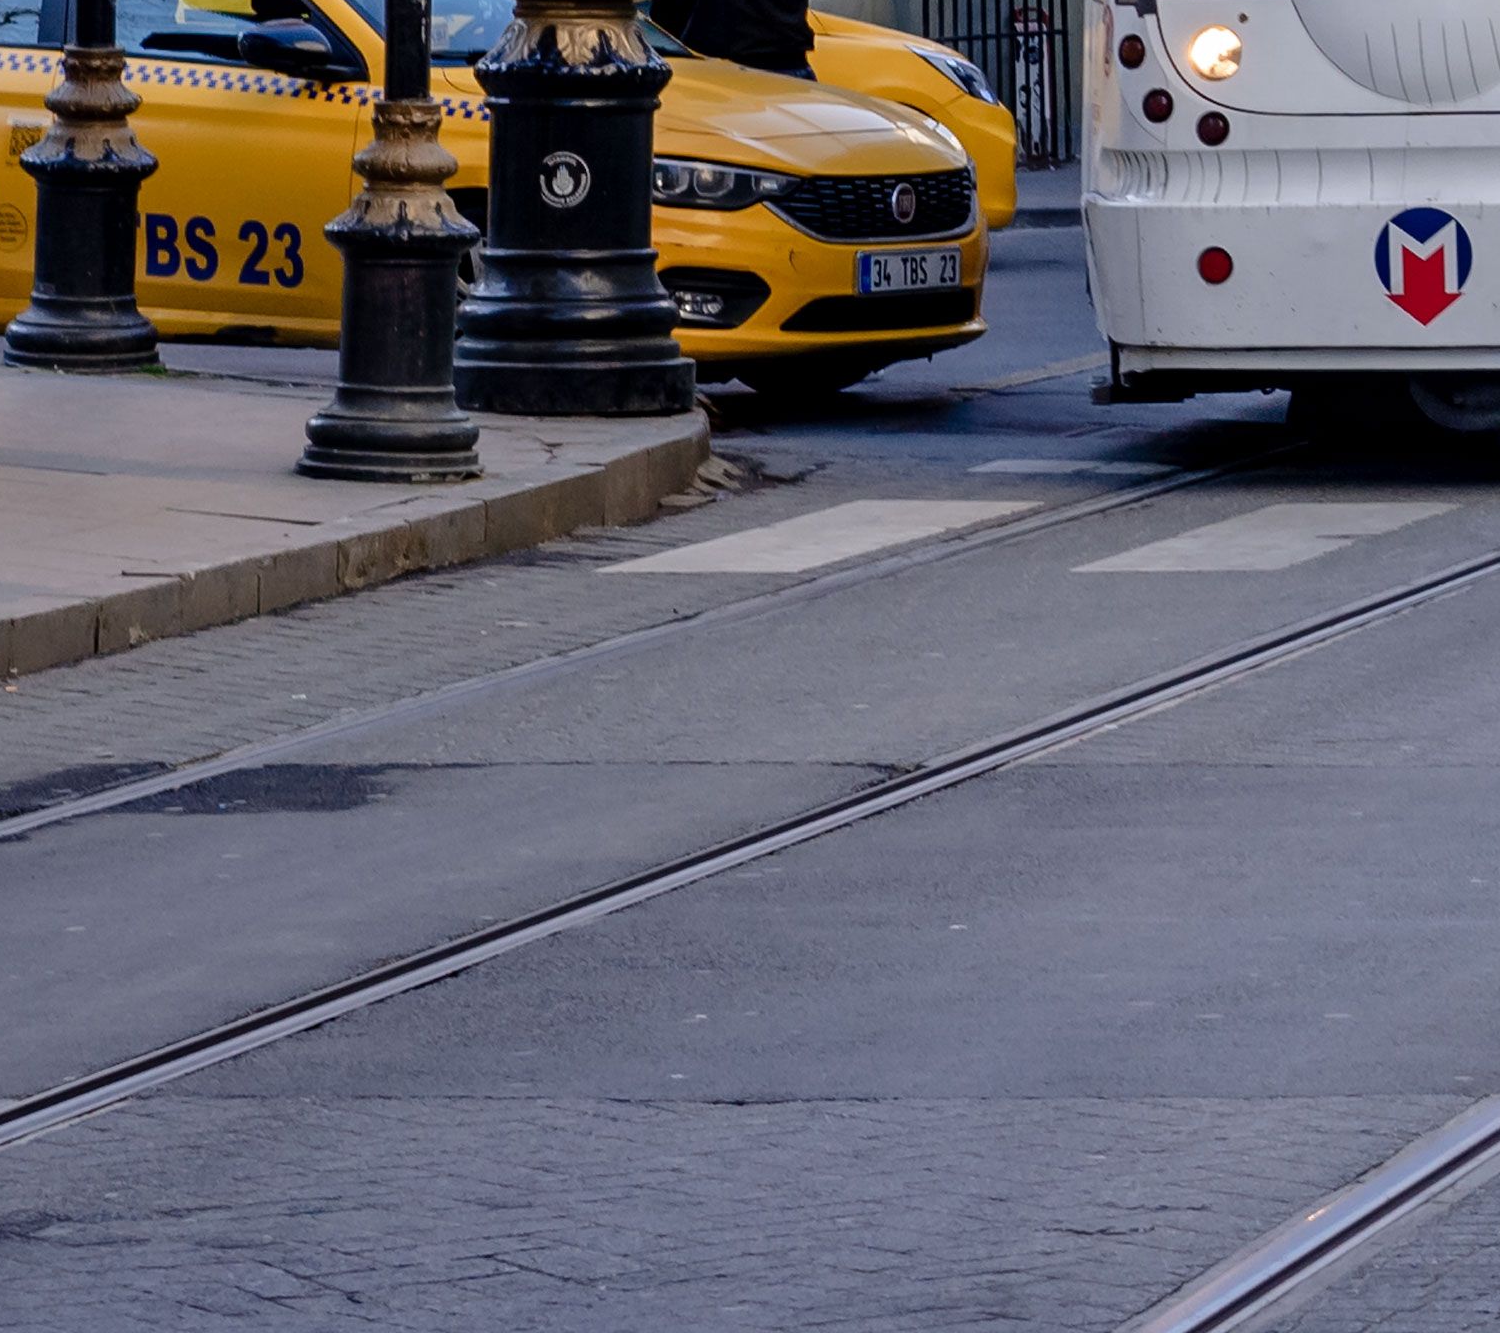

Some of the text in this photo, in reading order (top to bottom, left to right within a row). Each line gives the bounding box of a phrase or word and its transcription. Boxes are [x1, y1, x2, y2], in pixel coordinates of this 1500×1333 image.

[138, 213, 305, 288] BS 23
[873, 253, 958, 289] 34 TBS 23
